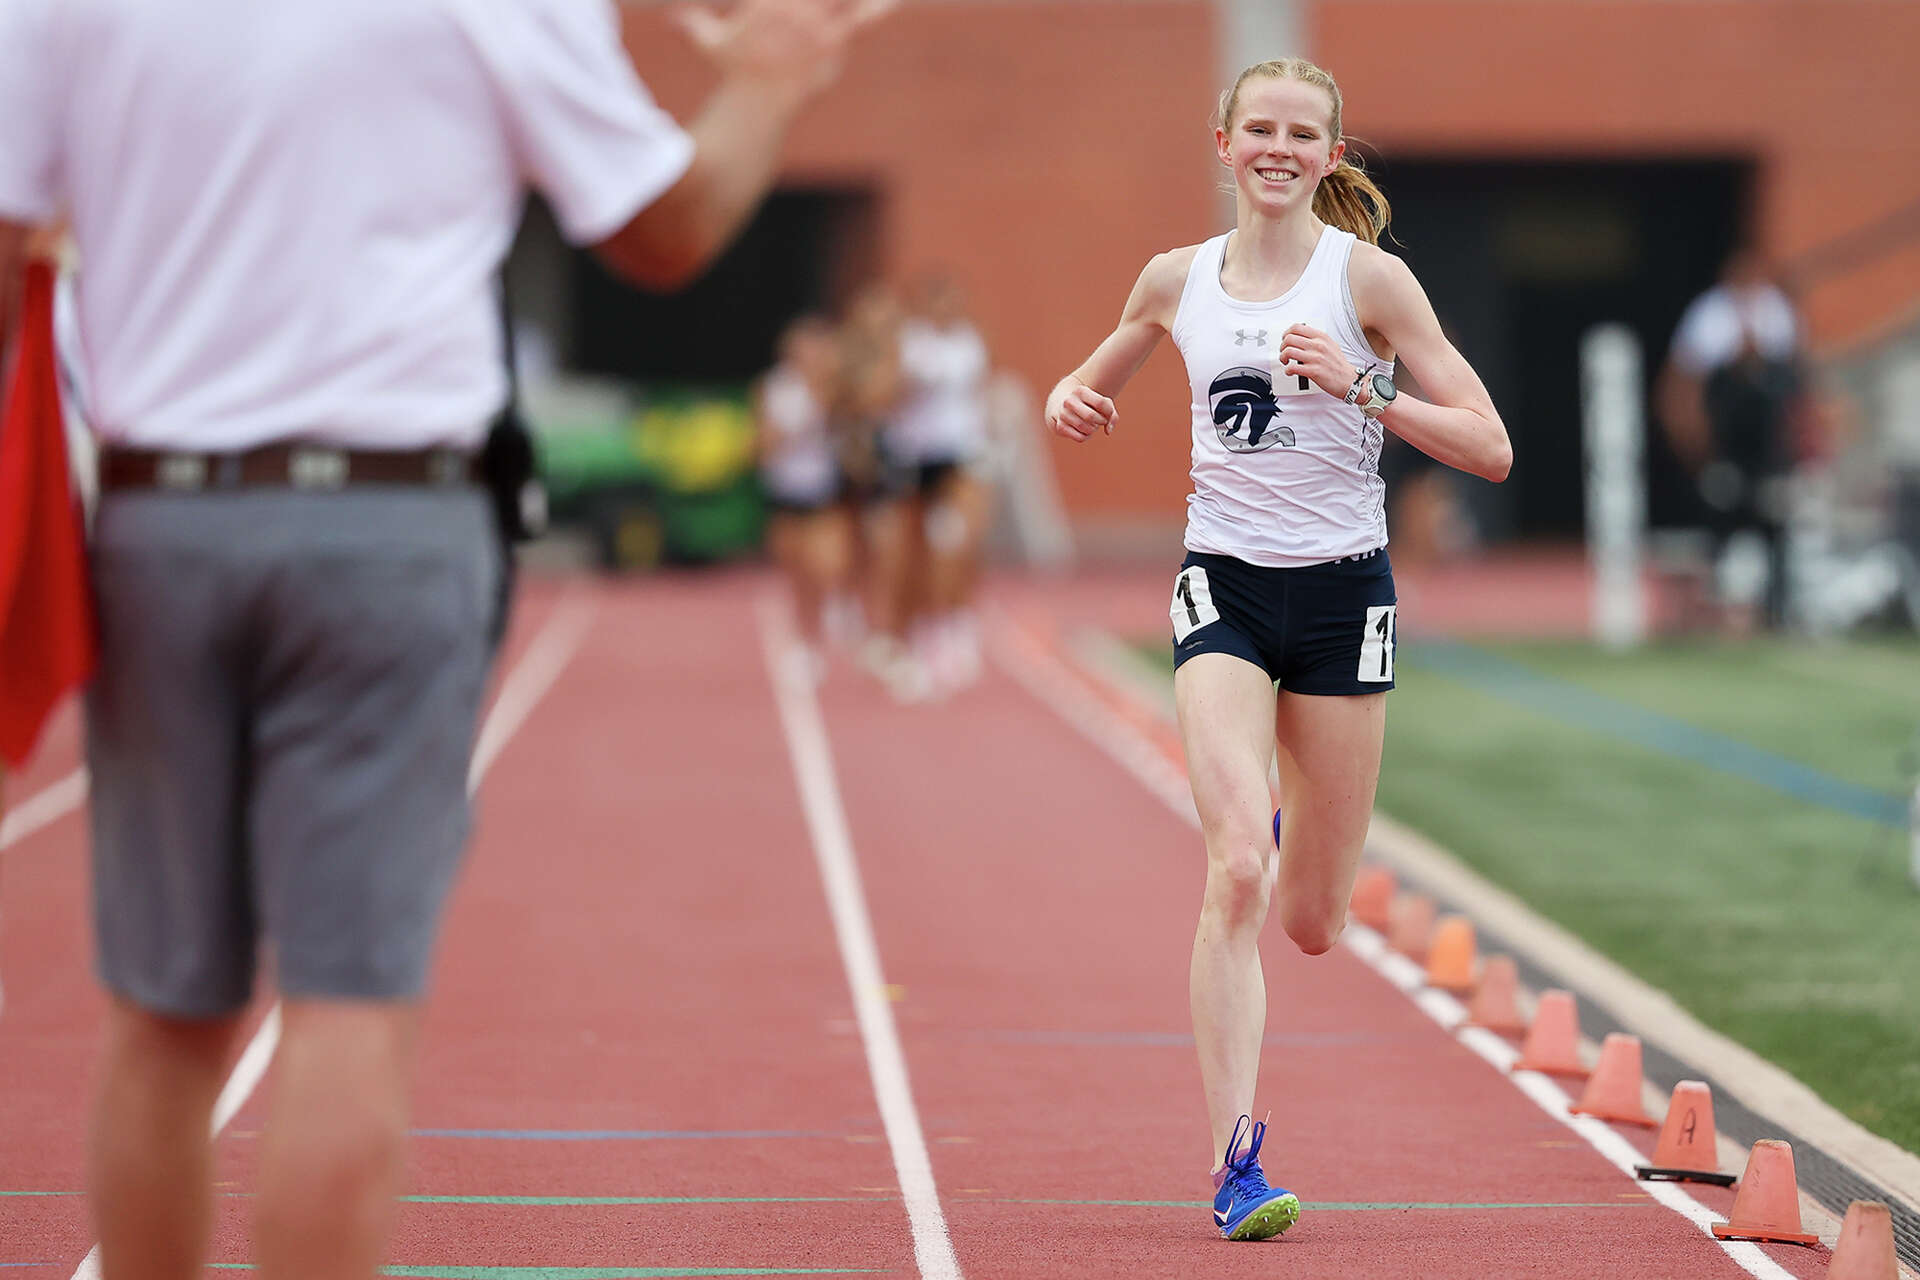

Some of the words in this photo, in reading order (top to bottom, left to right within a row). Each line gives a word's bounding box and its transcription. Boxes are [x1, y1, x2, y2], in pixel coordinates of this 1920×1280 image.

[1176, 573, 1201, 628] 1
[1375, 611, 1389, 677] 1
[1677, 1107, 1697, 1146] A
